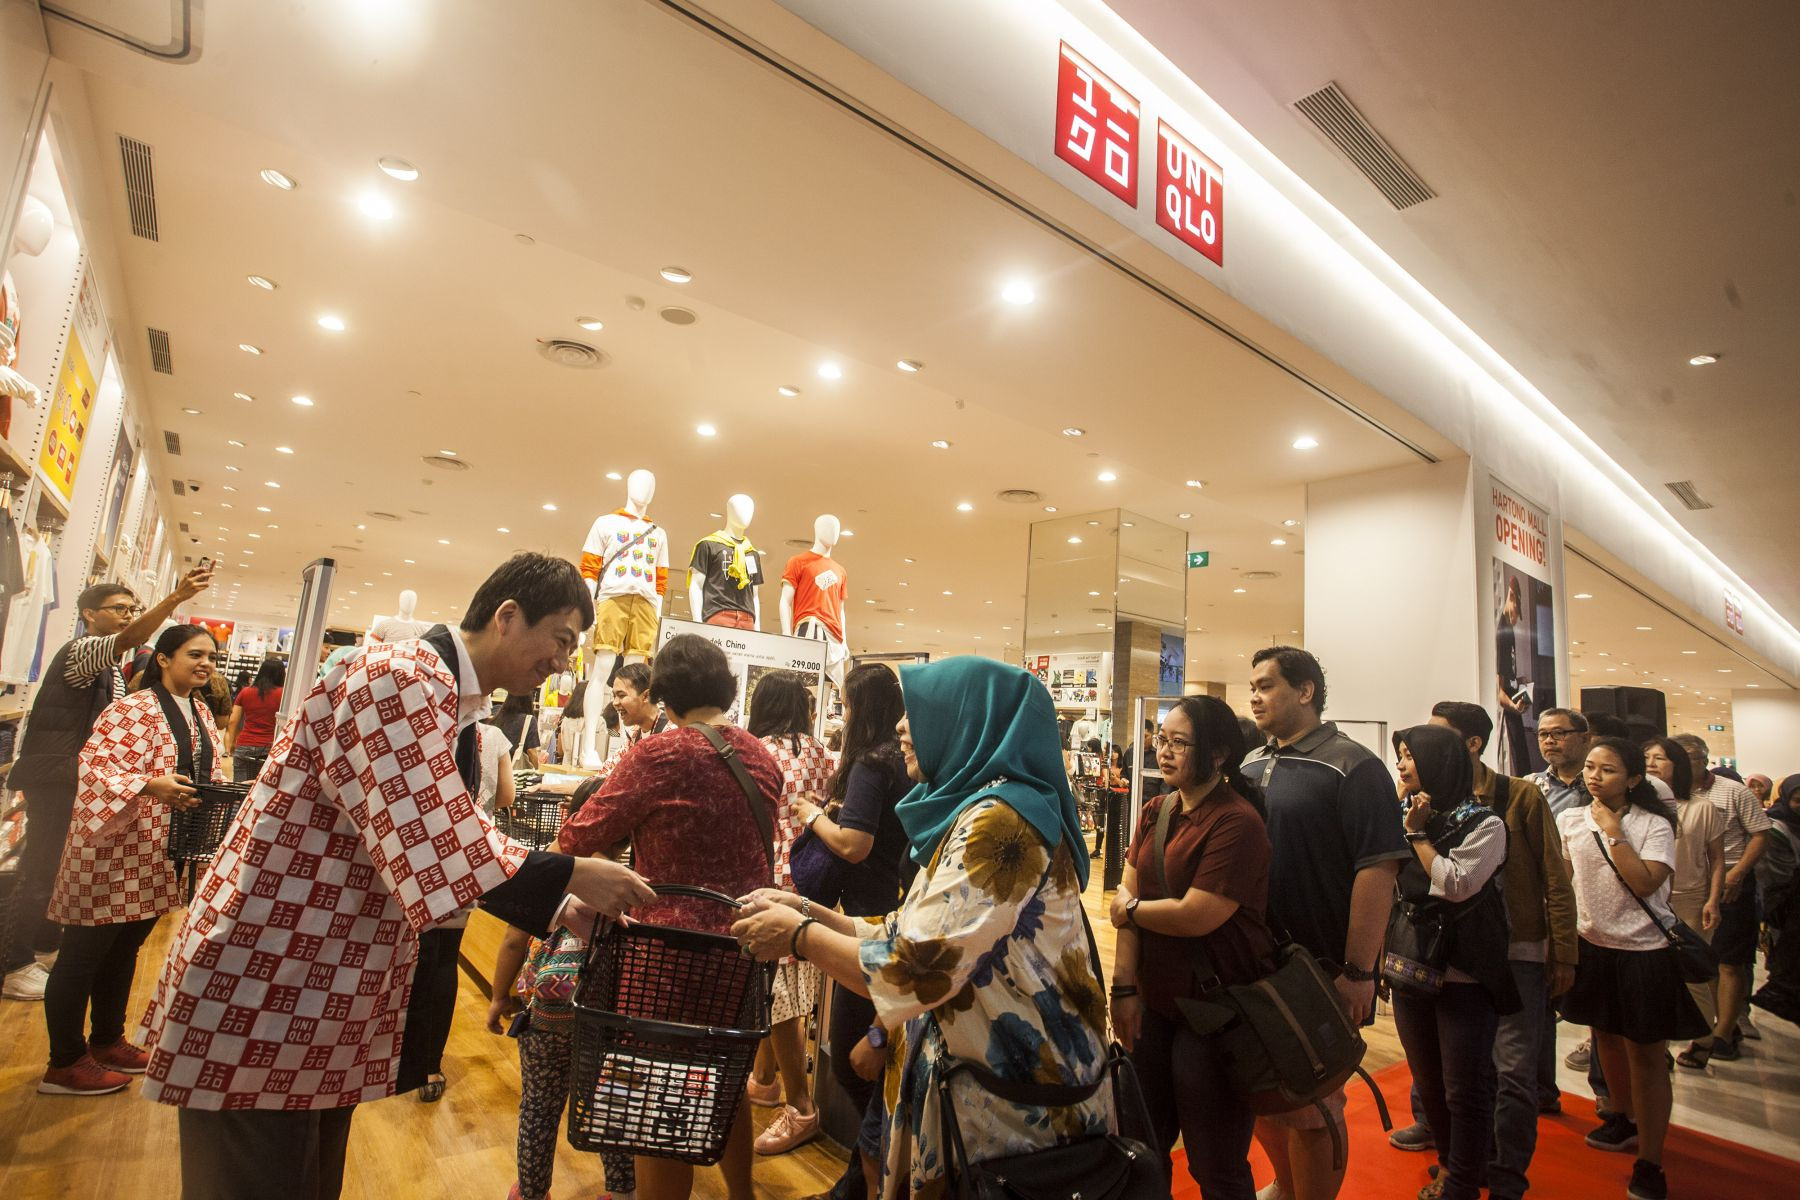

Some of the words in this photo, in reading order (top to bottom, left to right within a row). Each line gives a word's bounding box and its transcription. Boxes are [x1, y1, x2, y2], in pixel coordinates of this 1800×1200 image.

[1166, 137, 1213, 204] UNI
[1166, 184, 1216, 245] QLO
[1492, 488, 1525, 523] HARTONO
[1528, 511, 1547, 537] MALL
[1495, 514, 1547, 567] OPENING!
[725, 639, 746, 650] Chino
[791, 659, 821, 671] 299.000
[351, 693, 362, 711] QLO
[361, 688, 370, 705] UNI
[411, 718, 424, 735] QLO
[420, 711, 433, 729] UNI
[366, 741, 378, 758] QLO
[375, 735, 388, 752] UNI
[338, 761, 352, 779] UNI
[430, 760, 444, 777] QLO
[440, 753, 453, 771] UNI
[329, 768, 342, 785] QLO
[382, 782, 395, 801] QLO
[393, 777, 406, 795] UNI
[448, 802, 461, 820] QLO
[458, 796, 471, 814] UNI
[284, 824, 303, 835] UNI
[400, 828, 414, 846] QLO
[411, 822, 424, 839] UNI
[280, 834, 299, 846] QLO
[467, 847, 481, 865] QLO
[477, 841, 491, 859] UNI
[261, 873, 279, 885] UNI
[352, 866, 371, 877] UNI
[430, 866, 444, 885] UNI
[255, 884, 275, 895] QLO
[349, 877, 368, 887] QLO
[419, 872, 432, 891] QLO
[236, 924, 257, 934] UNI
[380, 923, 396, 932] UNI
[232, 934, 255, 945] QLO
[376, 934, 394, 942] QLO
[312, 965, 331, 976] UNI
[213, 975, 234, 986] UNI
[308, 977, 329, 988] QLO
[206, 986, 230, 999] QLO
[292, 1019, 313, 1030] UNI
[188, 1031, 208, 1042] UNI
[289, 1031, 311, 1041] QLO
[183, 1042, 206, 1055] QLO
[271, 1072, 292, 1080] UNI
[266, 1081, 289, 1090] QLO
